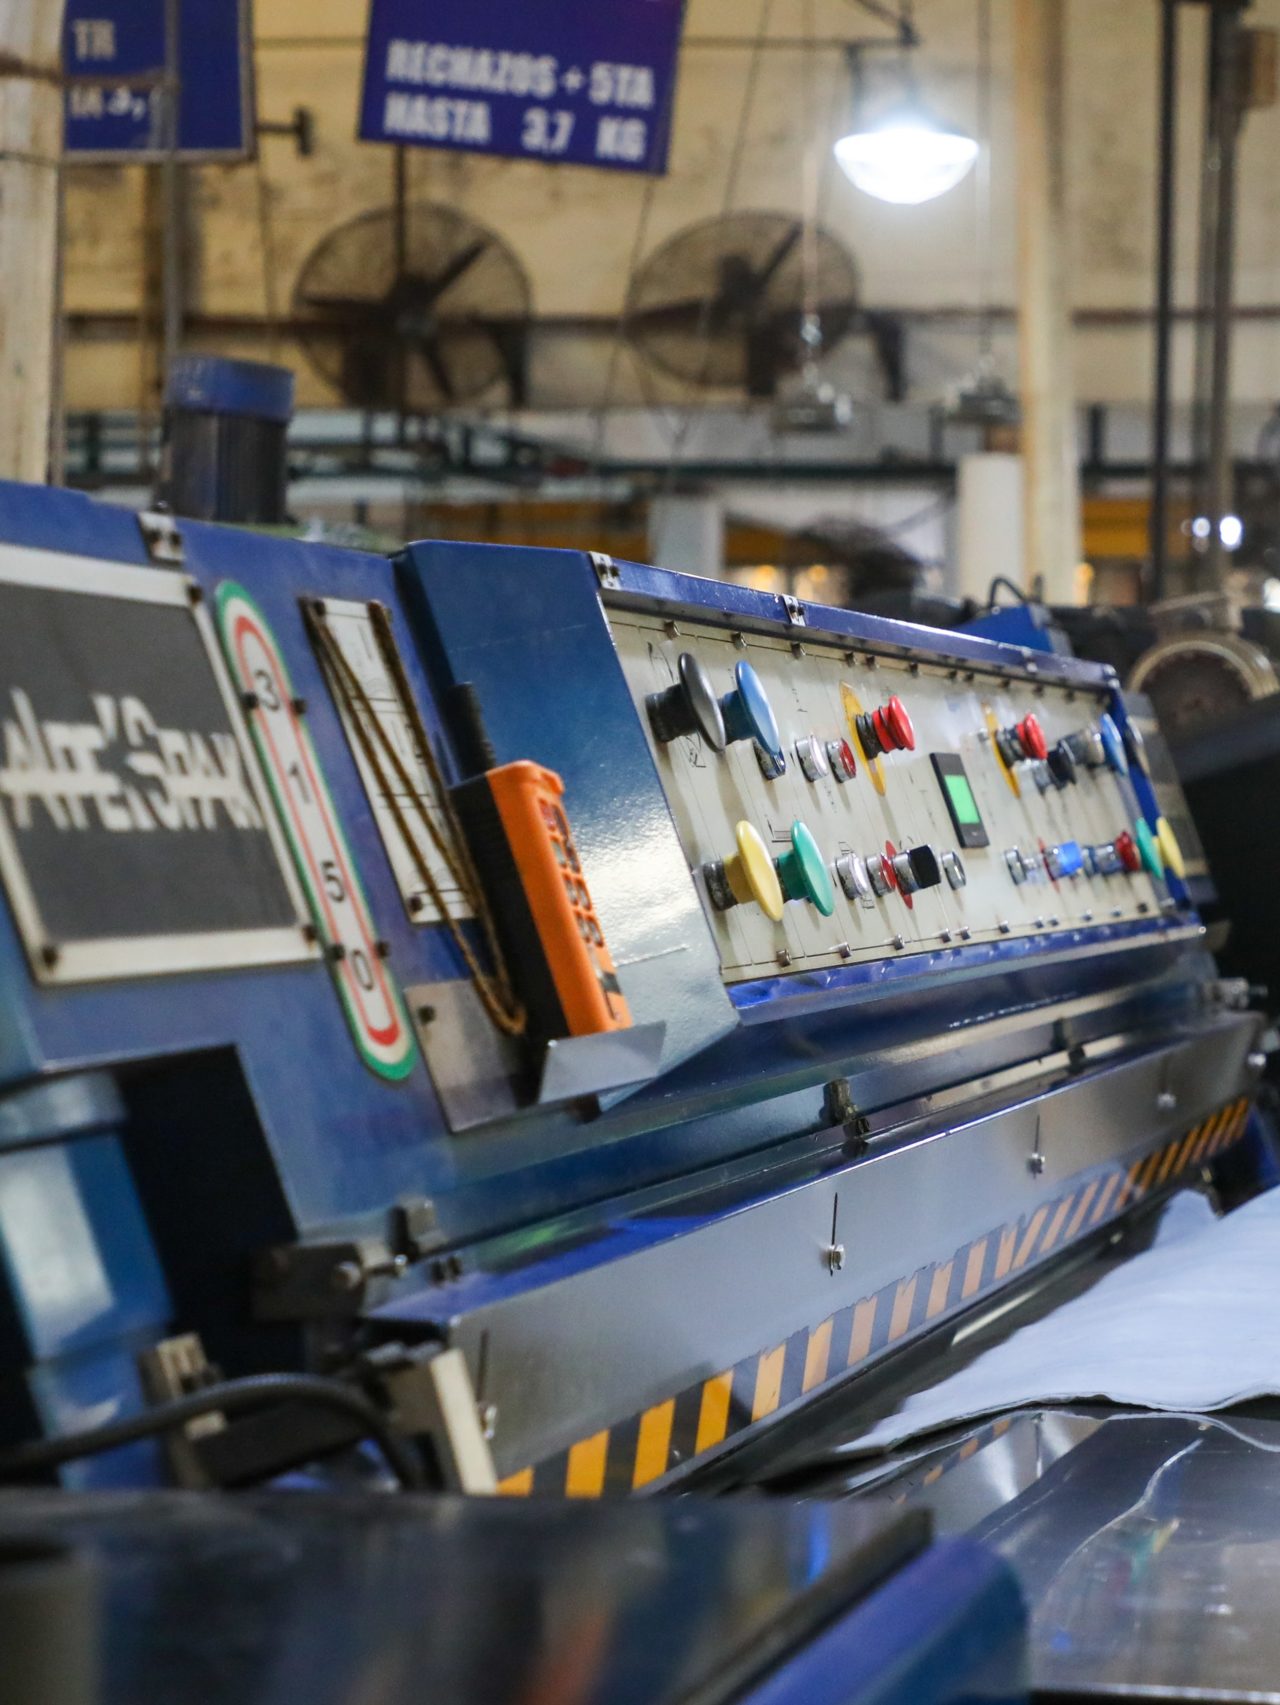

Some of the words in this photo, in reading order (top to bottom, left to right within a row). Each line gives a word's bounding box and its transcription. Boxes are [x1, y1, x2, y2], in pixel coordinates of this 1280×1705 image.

[385, 38, 557, 98] RECHAZOS
[383, 91, 492, 144] HASTA
[595, 115, 648, 162] KG
